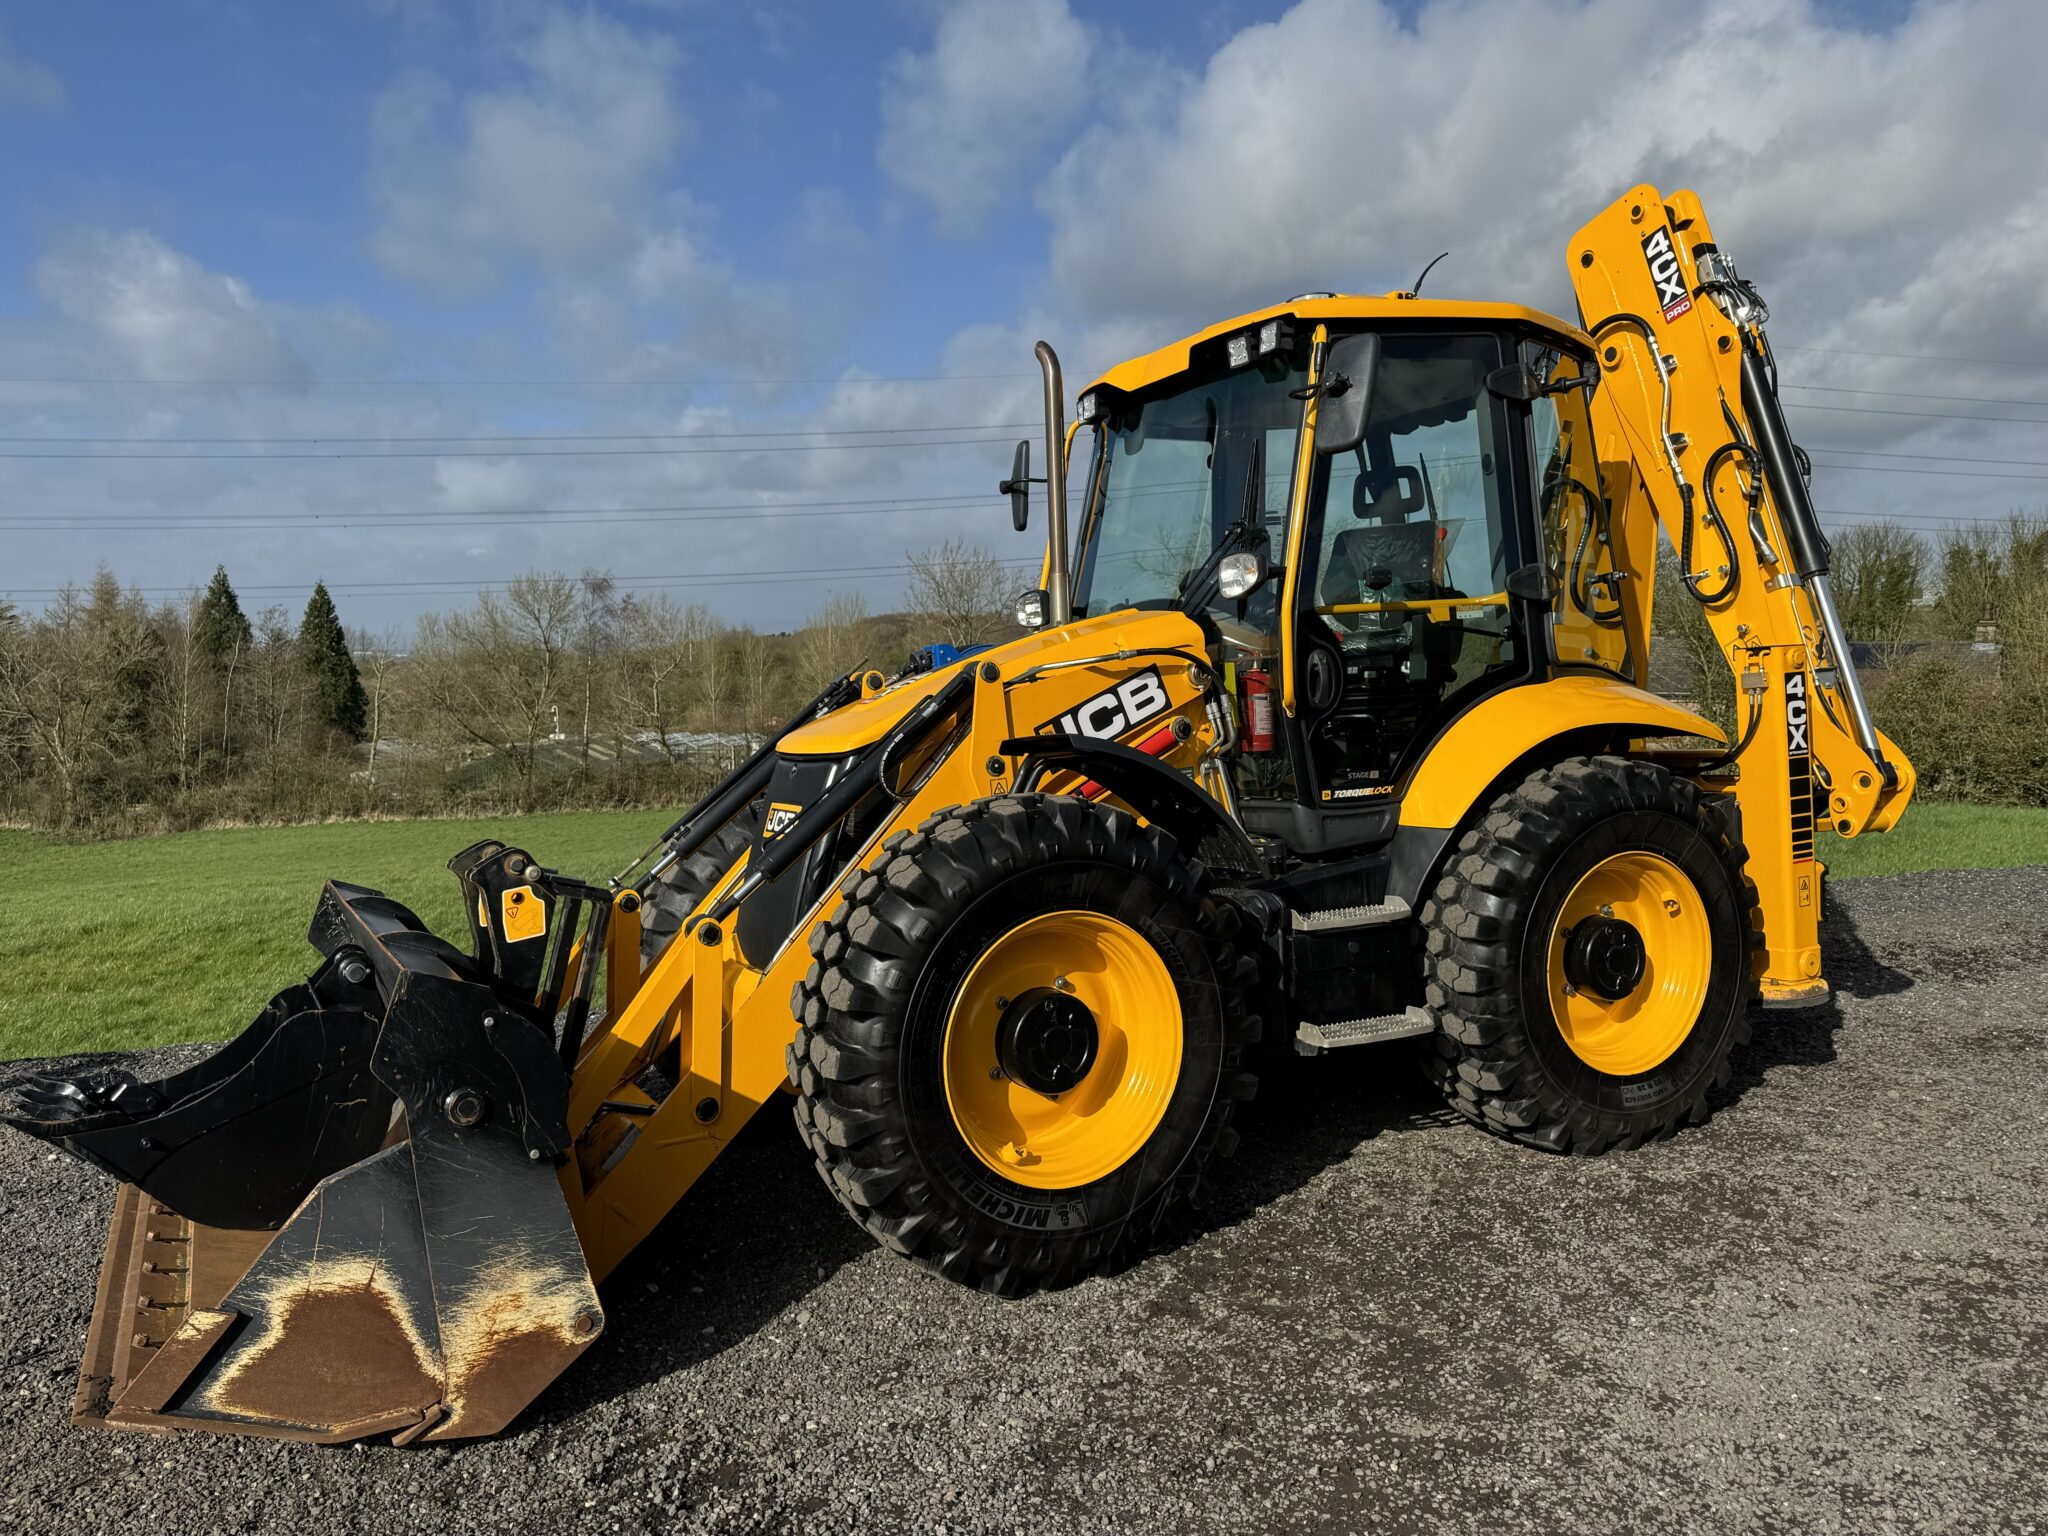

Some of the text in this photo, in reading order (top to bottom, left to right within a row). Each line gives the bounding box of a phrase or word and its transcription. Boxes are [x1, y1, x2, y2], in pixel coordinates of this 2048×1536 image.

[1646, 229, 1686, 306] 4CX
[1666, 301, 1690, 321] PRO
[1786, 674, 1808, 750] 4CX
[1347, 772, 1370, 780] STAGE
[1333, 785, 1394, 799] TORQUELOCK
